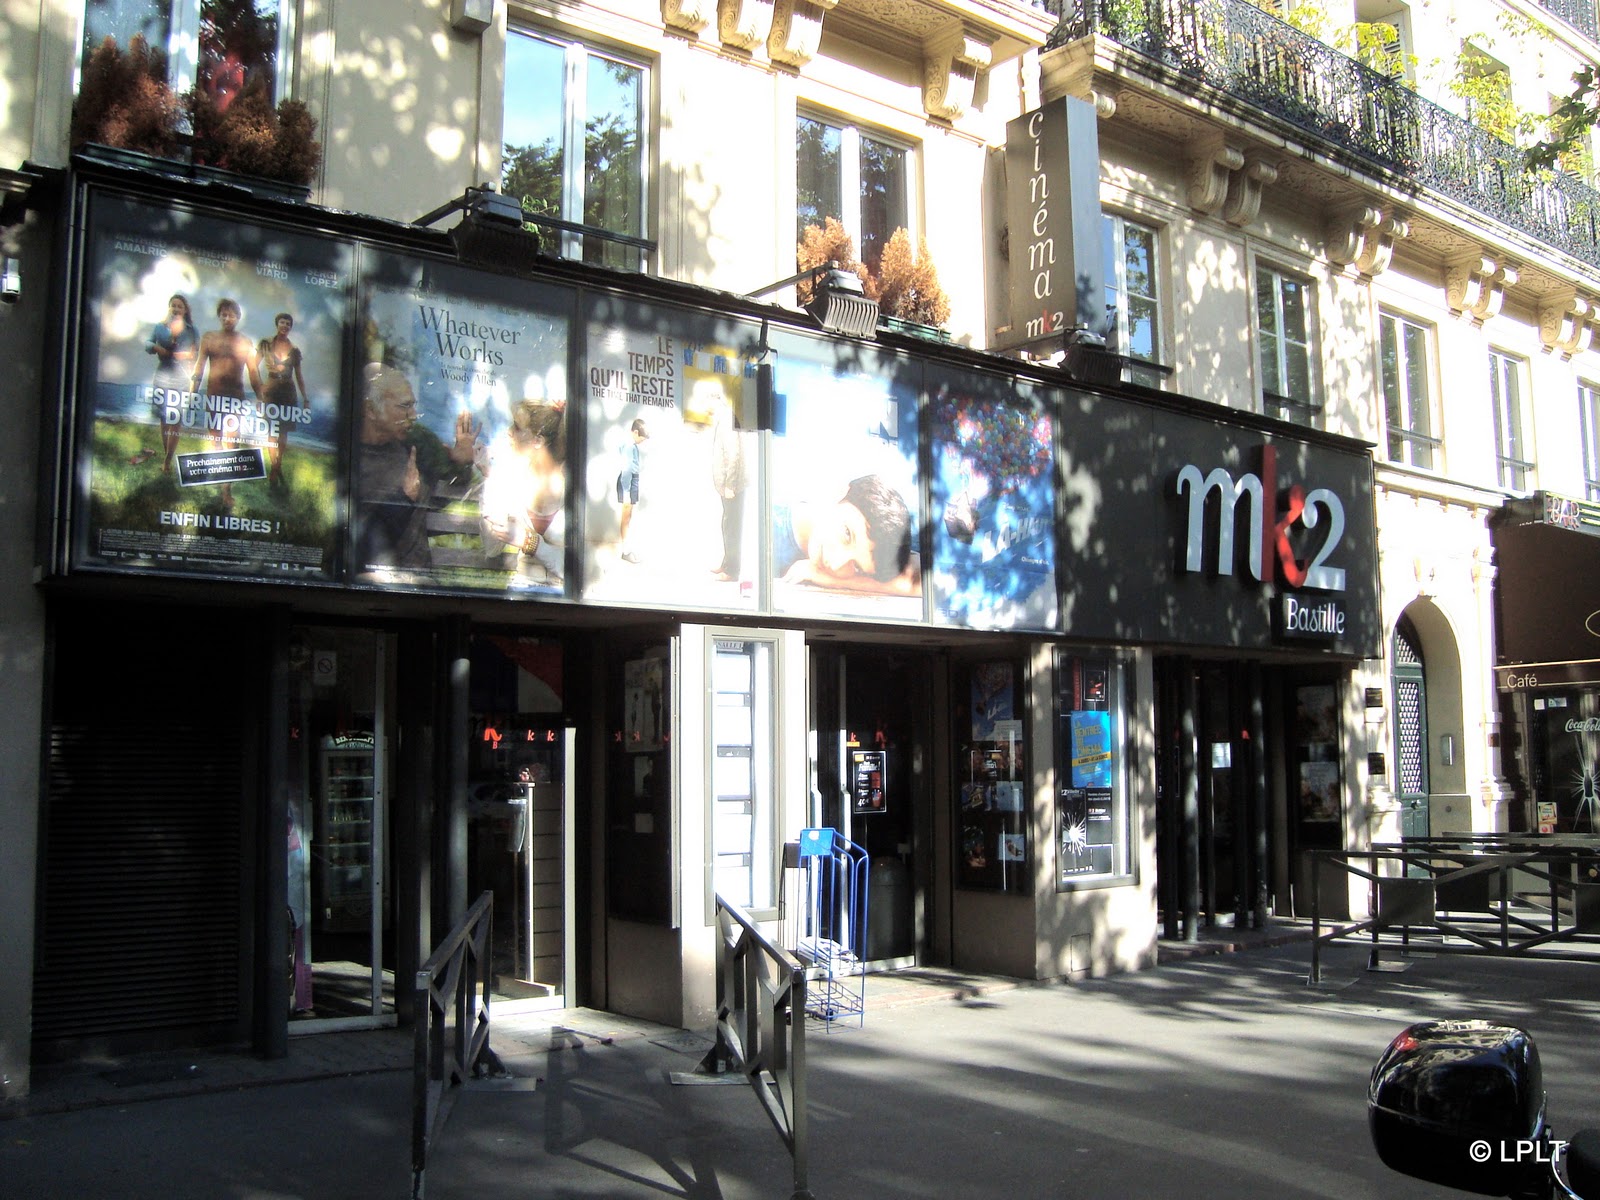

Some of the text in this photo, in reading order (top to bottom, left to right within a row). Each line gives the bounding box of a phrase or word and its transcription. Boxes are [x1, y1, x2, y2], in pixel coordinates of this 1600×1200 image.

[1028, 111, 1056, 300] cinéma
[114, 241, 168, 257] AMALRIC
[197, 257, 228, 269] FROT
[256, 267, 288, 280] VIARD
[304, 276, 338, 289] LOPEZ
[419, 305, 521, 345] Whatever
[1025, 309, 1064, 338] mk2
[436, 332, 504, 366] Works
[657, 336, 674, 357] LE
[627, 351, 674, 377] TEMPS
[440, 368, 496, 387] Woody Allen
[590, 367, 674, 398] QU'IL RESTE
[135, 386, 312, 424] LES DERNIERS JOURS
[592, 386, 606, 398] THE
[625, 392, 641, 404] THAT
[642, 395, 674, 409] REMAINS
[165, 406, 280, 437] DU MONDE
[187, 456, 237, 468] Prochainement
[189, 467, 207, 476] votre
[160, 511, 210, 528] ENFIN
[215, 514, 272, 534] LIBRES
[1177, 444, 1346, 592] mk2
[1286, 598, 1345, 634] Bastille
[1507, 673, 1538, 688] Café
